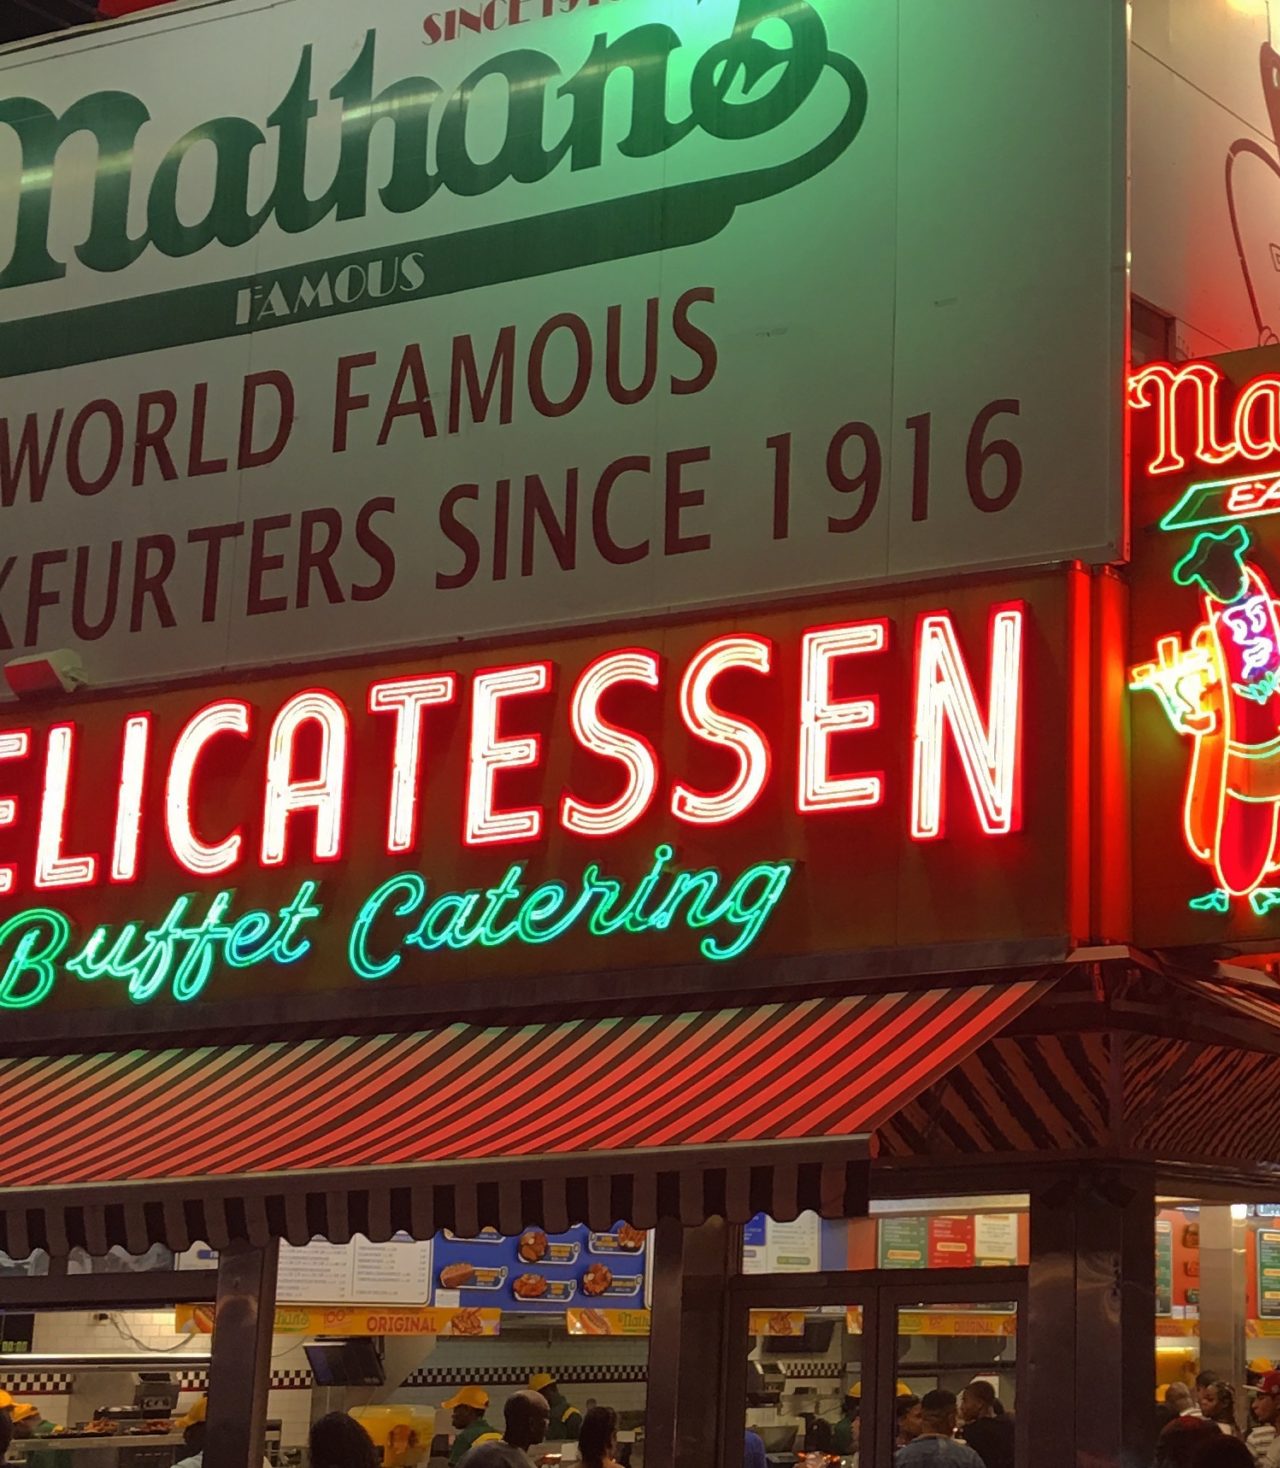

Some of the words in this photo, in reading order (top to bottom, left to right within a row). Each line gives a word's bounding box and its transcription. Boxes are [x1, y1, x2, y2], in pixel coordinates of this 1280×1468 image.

[421, 0, 530, 46] SINCE
[0, 0, 830, 289] Nathans
[235, 252, 425, 325] FAMOUS
[0, 368, 295, 503] WORLD
[332, 286, 719, 453] FAMOUS
[435, 445, 711, 590] SINCE
[765, 398, 1023, 541] 1916
[0, 880, 321, 1010] Buffet
[348, 842, 795, 979] Catering
[366, 1314, 438, 1333] ORIGINAL
